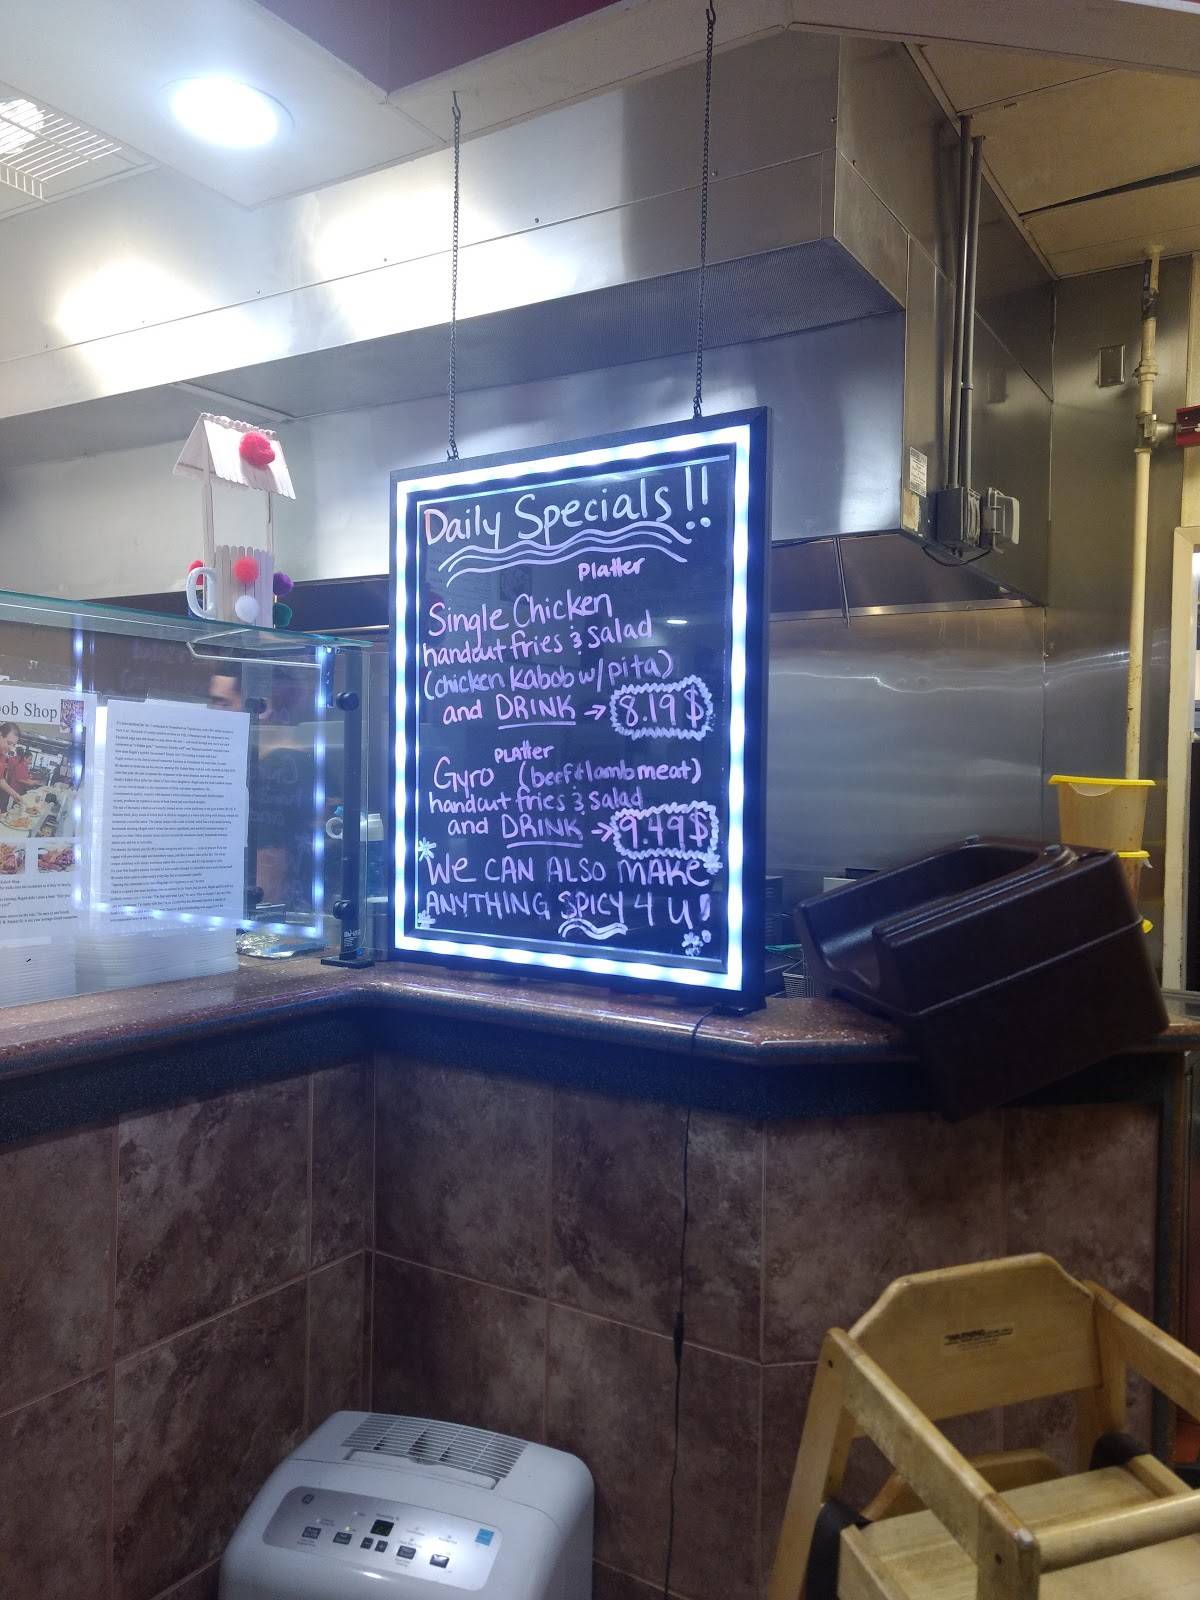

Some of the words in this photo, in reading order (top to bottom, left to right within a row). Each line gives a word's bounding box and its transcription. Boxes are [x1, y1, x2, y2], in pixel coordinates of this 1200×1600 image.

[423, 504, 501, 549] Daily
[428, 601, 509, 652] Single
[513, 588, 613, 628] Chicken
[510, 629, 563, 660] fries
[0, 701, 19, 716] ob
[24, 702, 58, 722] Shop
[443, 699, 483, 725] and
[496, 693, 576, 720] DRINK
[433, 755, 495, 799] Gyro
[515, 786, 567, 813] fries
[447, 816, 489, 837] and
[501, 812, 584, 841] DRINK
[484, 855, 534, 884] CAN
[546, 856, 608, 884] ALSO
[426, 890, 551, 921] ANYTHING
[557, 890, 625, 924] SPICY
[633, 891, 655, 927] 4
